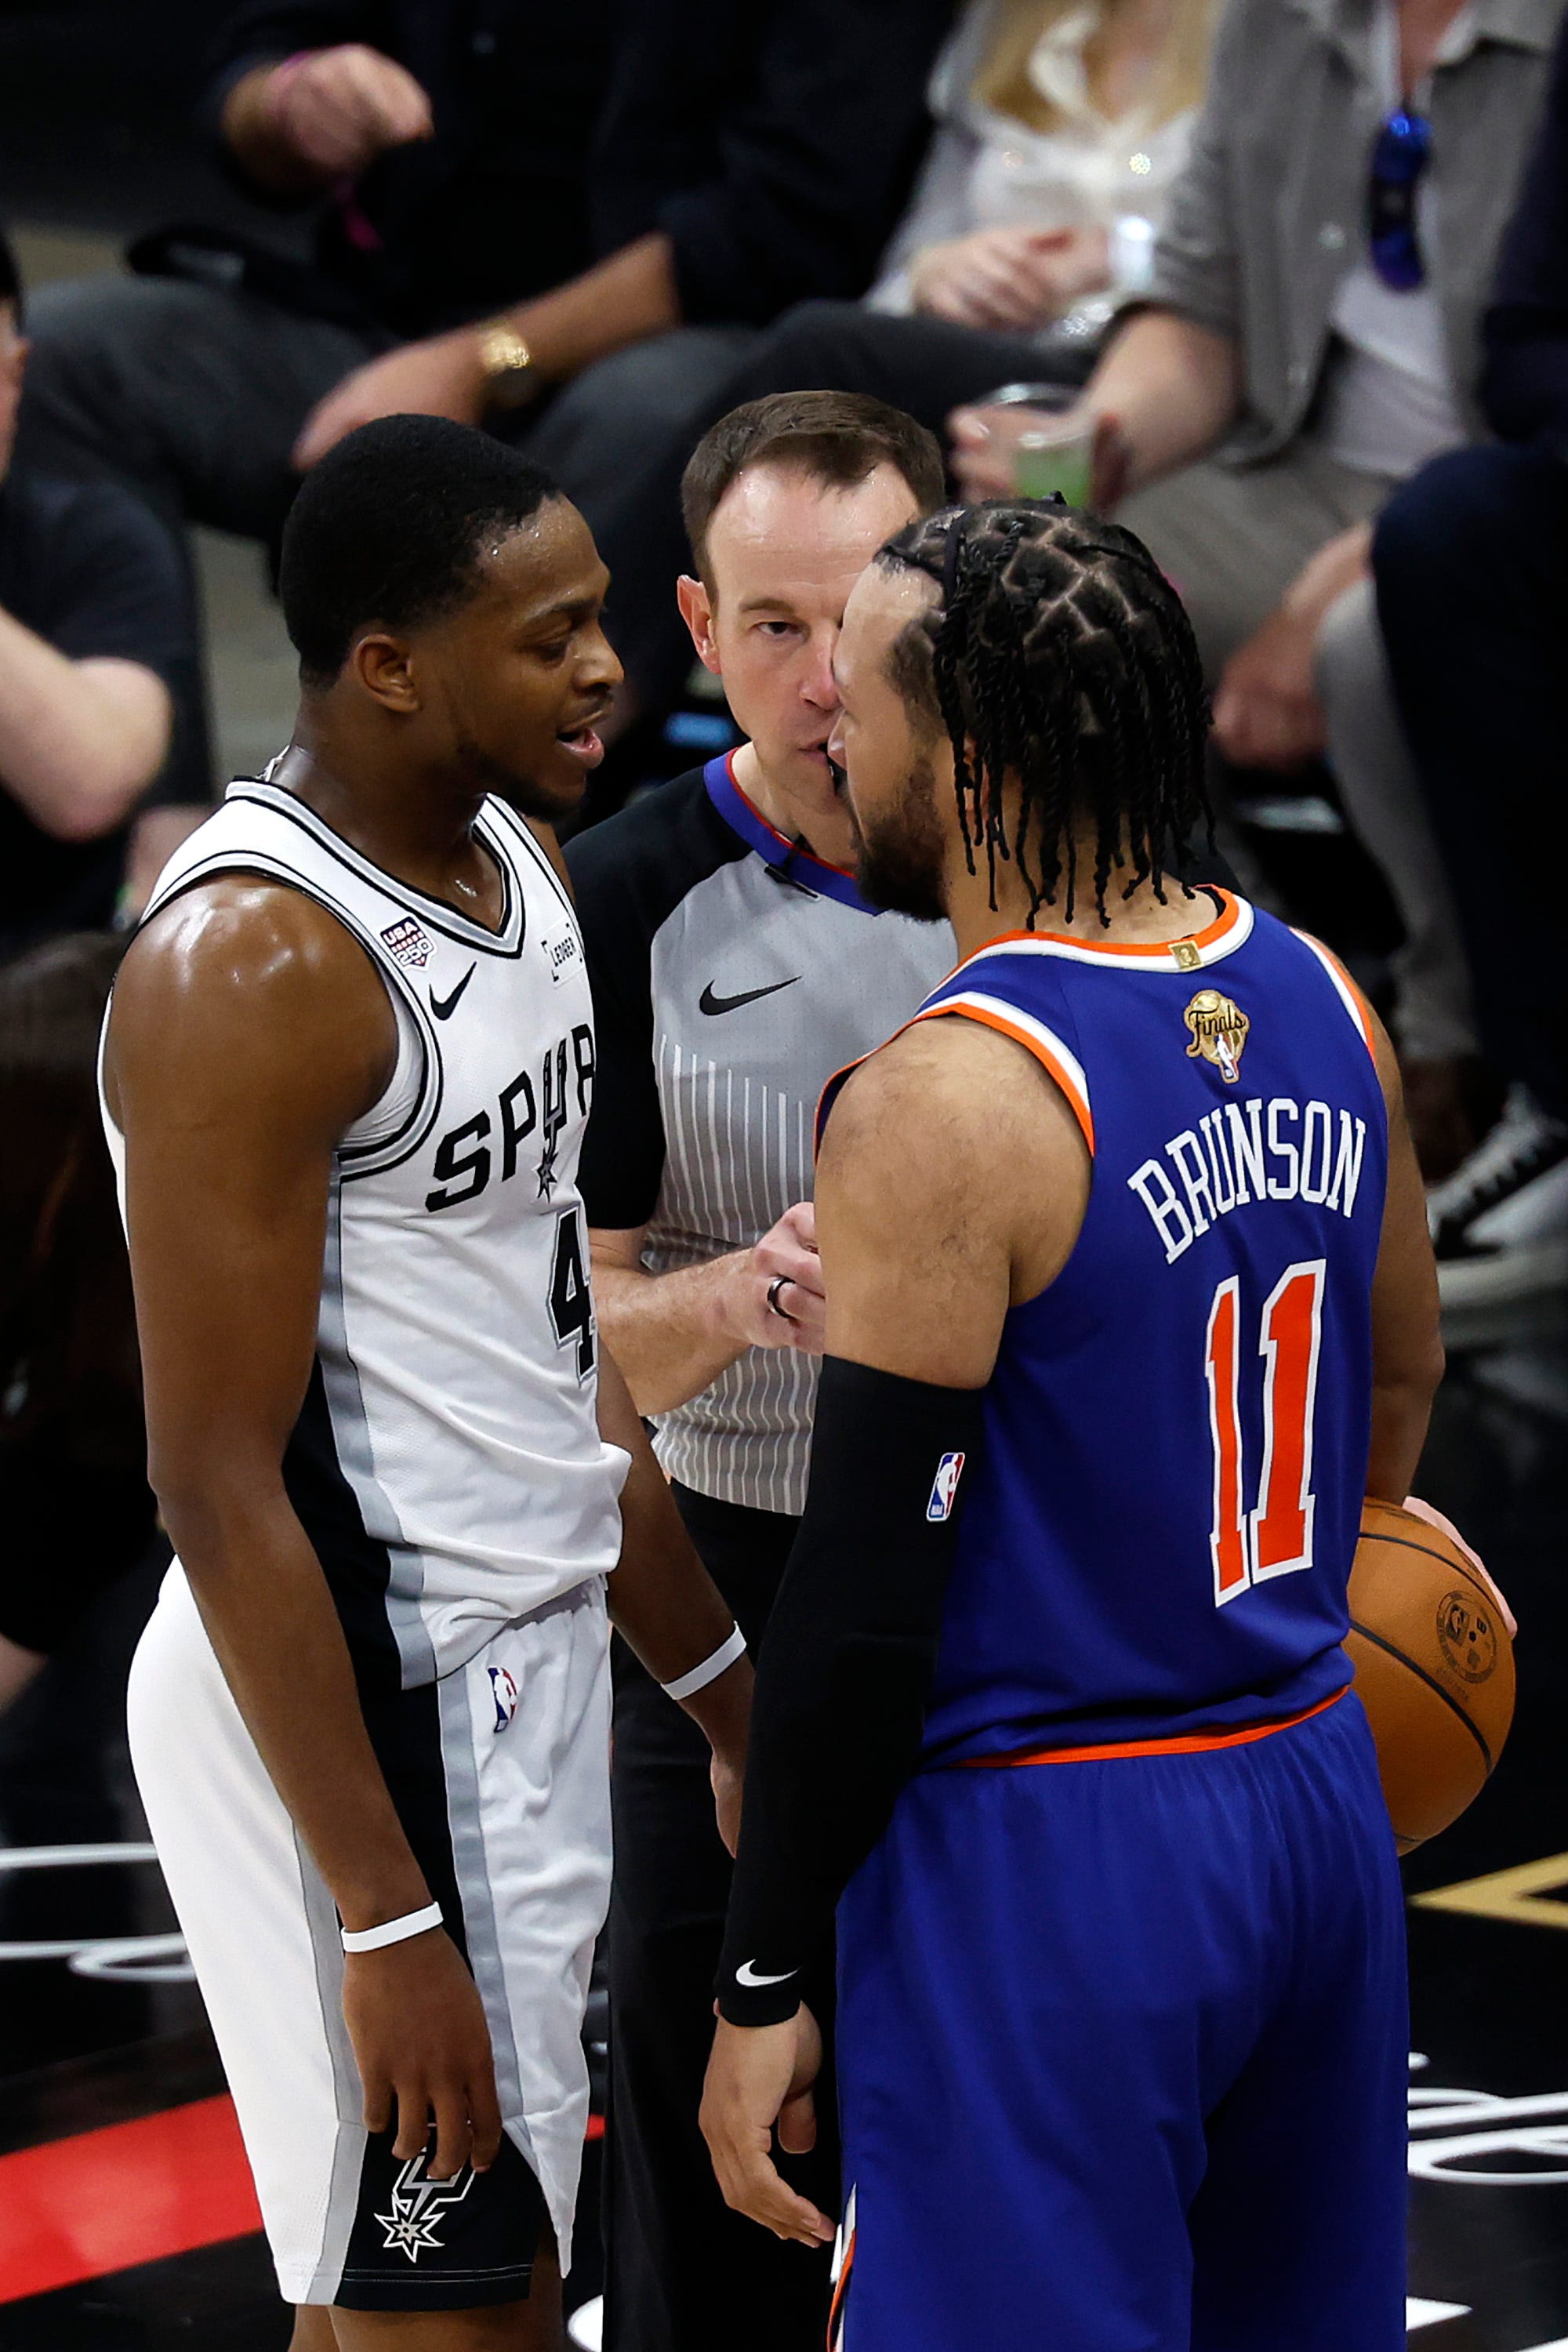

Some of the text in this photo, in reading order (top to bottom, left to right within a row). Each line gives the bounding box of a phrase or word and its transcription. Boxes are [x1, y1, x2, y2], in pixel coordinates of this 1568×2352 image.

[383, 921, 418, 945] USA
[396, 938, 434, 966] 250
[1189, 1004, 1246, 1052] Finals
[1127, 1098, 1366, 1265] BRUNSON
[546, 1201, 598, 1388] 4
[1205, 1258, 1327, 1608] 11
